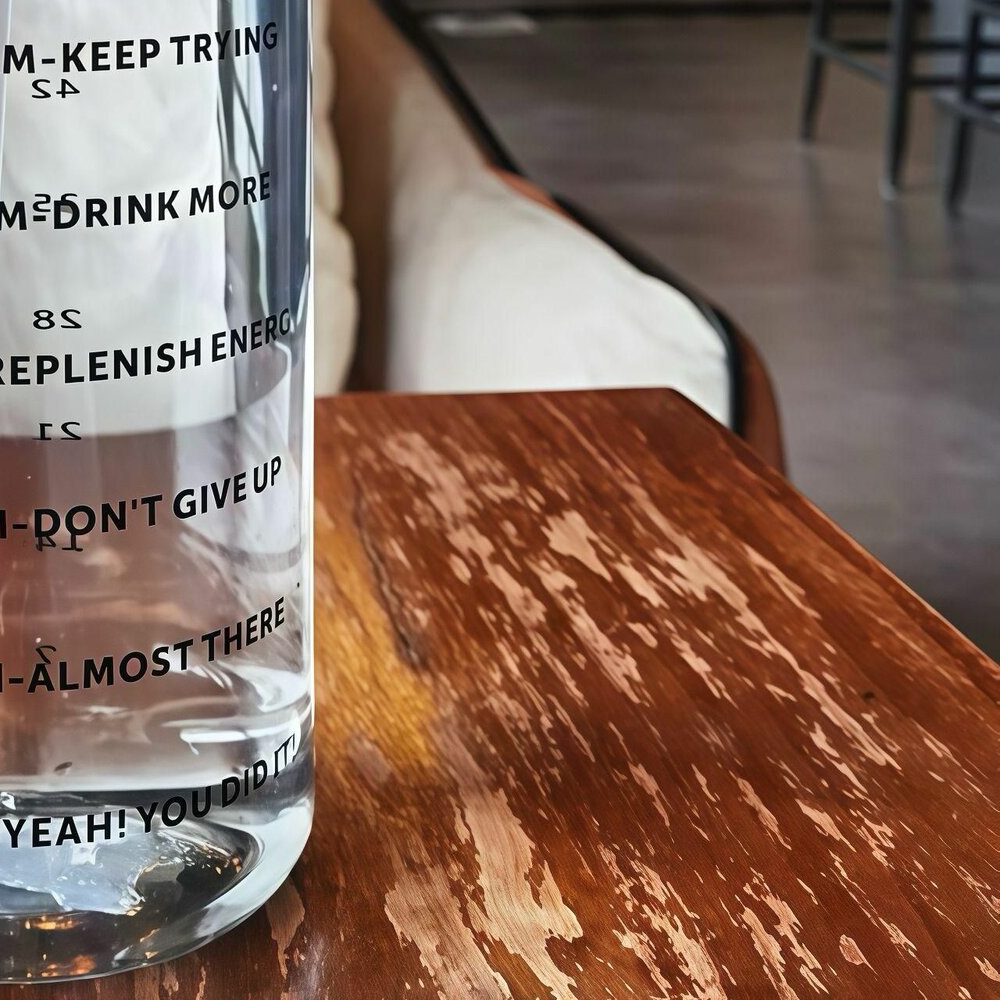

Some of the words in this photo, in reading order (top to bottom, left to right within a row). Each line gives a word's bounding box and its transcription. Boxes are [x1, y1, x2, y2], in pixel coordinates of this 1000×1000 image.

[169, 22, 278, 66] TRYING
[189, 171, 271, 217] MORE
[172, 471, 247, 520] GIVE
[253, 455, 282, 494] UP
[201, 596, 285, 662] THERE
[135, 785, 212, 834] YOU
[221, 760, 268, 808] DID
